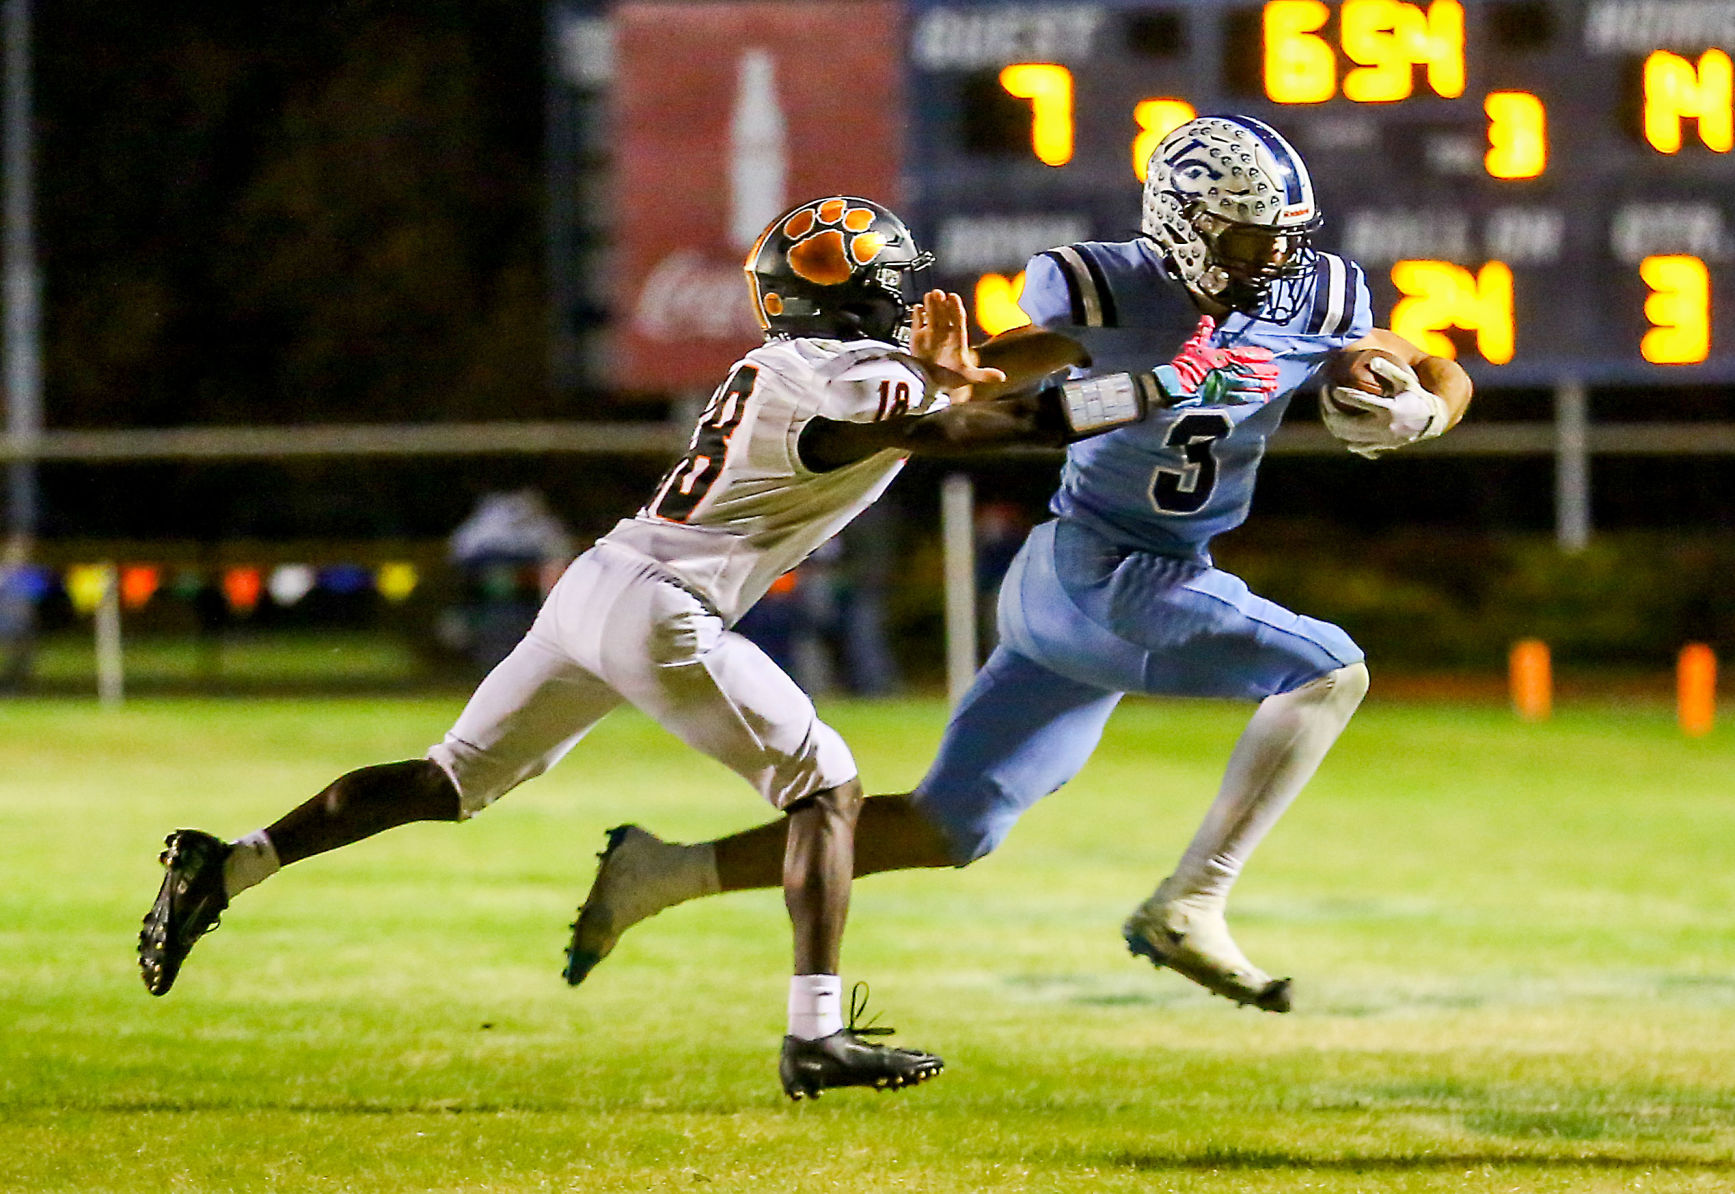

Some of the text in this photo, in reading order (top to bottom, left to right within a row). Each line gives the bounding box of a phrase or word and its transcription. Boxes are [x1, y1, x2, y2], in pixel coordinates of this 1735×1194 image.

[1000, 62, 1074, 167] 7
[1484, 91, 1547, 180] 3
[1390, 259, 1516, 365] 24
[1639, 254, 1711, 365] 3
[1148, 408, 1235, 516] 3
